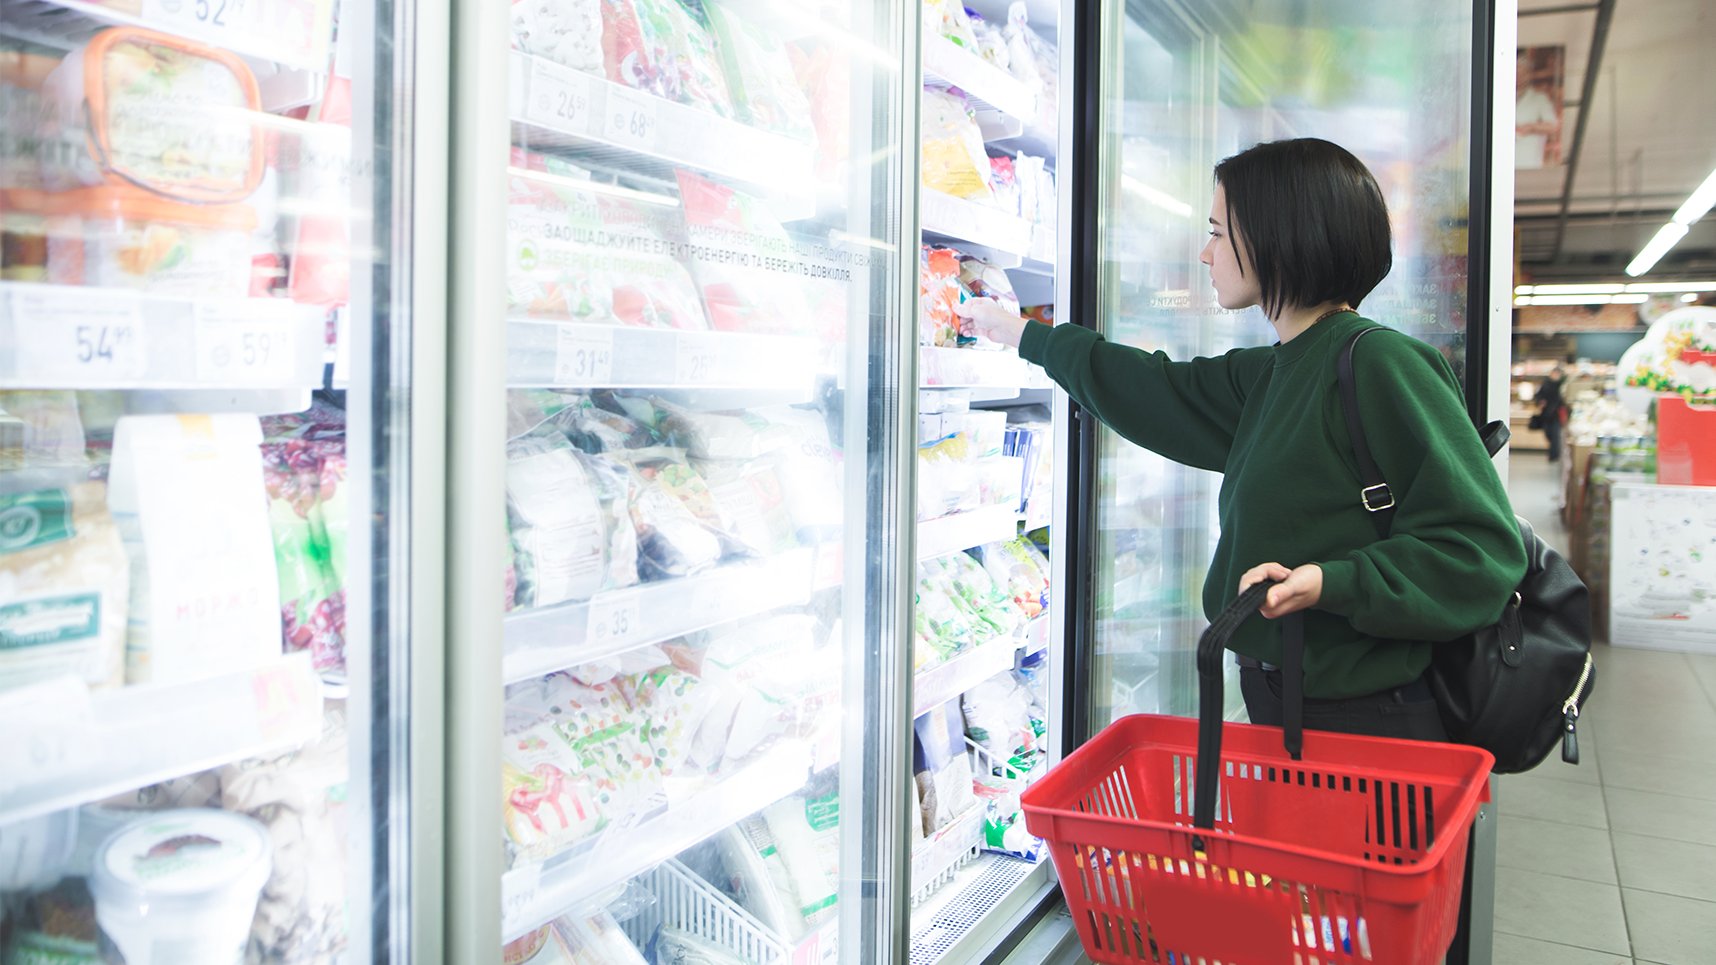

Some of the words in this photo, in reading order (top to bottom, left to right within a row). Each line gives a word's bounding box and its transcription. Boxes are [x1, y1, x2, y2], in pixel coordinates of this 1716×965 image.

[544, 223, 650, 253] ЗАОЩАДЖУЙТЕ
[653, 239, 749, 267] ЕЛЕКТРОЕНЕРГІЮ
[752, 254, 762, 269] ТА
[765, 256, 809, 277] БЕРЕЖІТЬ
[810, 264, 852, 282] ДОВКІЛЛЯ.
[544, 249, 609, 272] ЗБЕРІГАЄ
[686, 222, 728, 244] КАМЕРИ
[730, 229, 787, 254] ЗБЕРІГАЮТЬ
[790, 239, 811, 257] НАШІ
[813, 245, 853, 264] ПРОДУКТИ
[176, 587, 259, 622] МОРЖО
